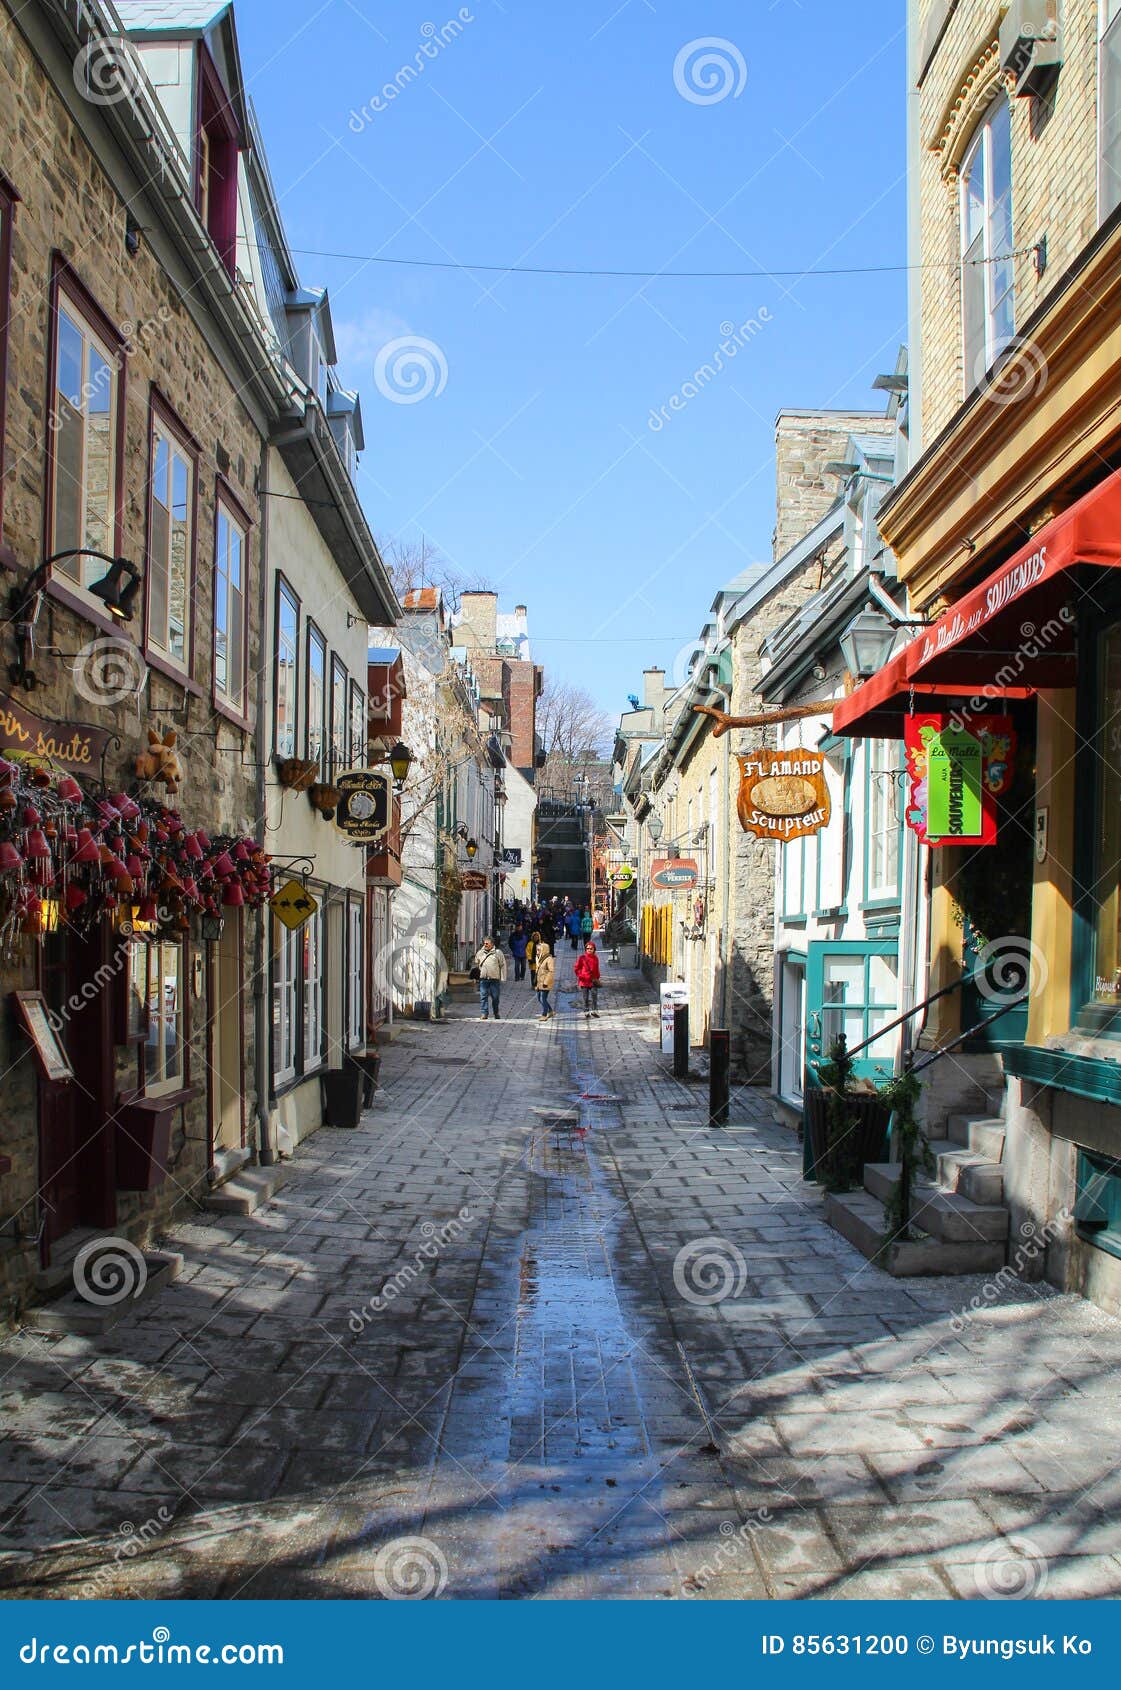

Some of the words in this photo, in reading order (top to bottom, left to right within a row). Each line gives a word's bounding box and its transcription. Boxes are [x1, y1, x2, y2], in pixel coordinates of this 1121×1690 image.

[934, 613, 966, 655] Malle
[984, 546, 1047, 619] SOUVENIRS
[37, 731, 92, 764] sauté
[949, 745, 979, 757] Malle
[743, 760, 821, 777] FLAMAND
[949, 760, 963, 835] SOUVENIRS
[747, 808, 826, 837] Sculpteur
